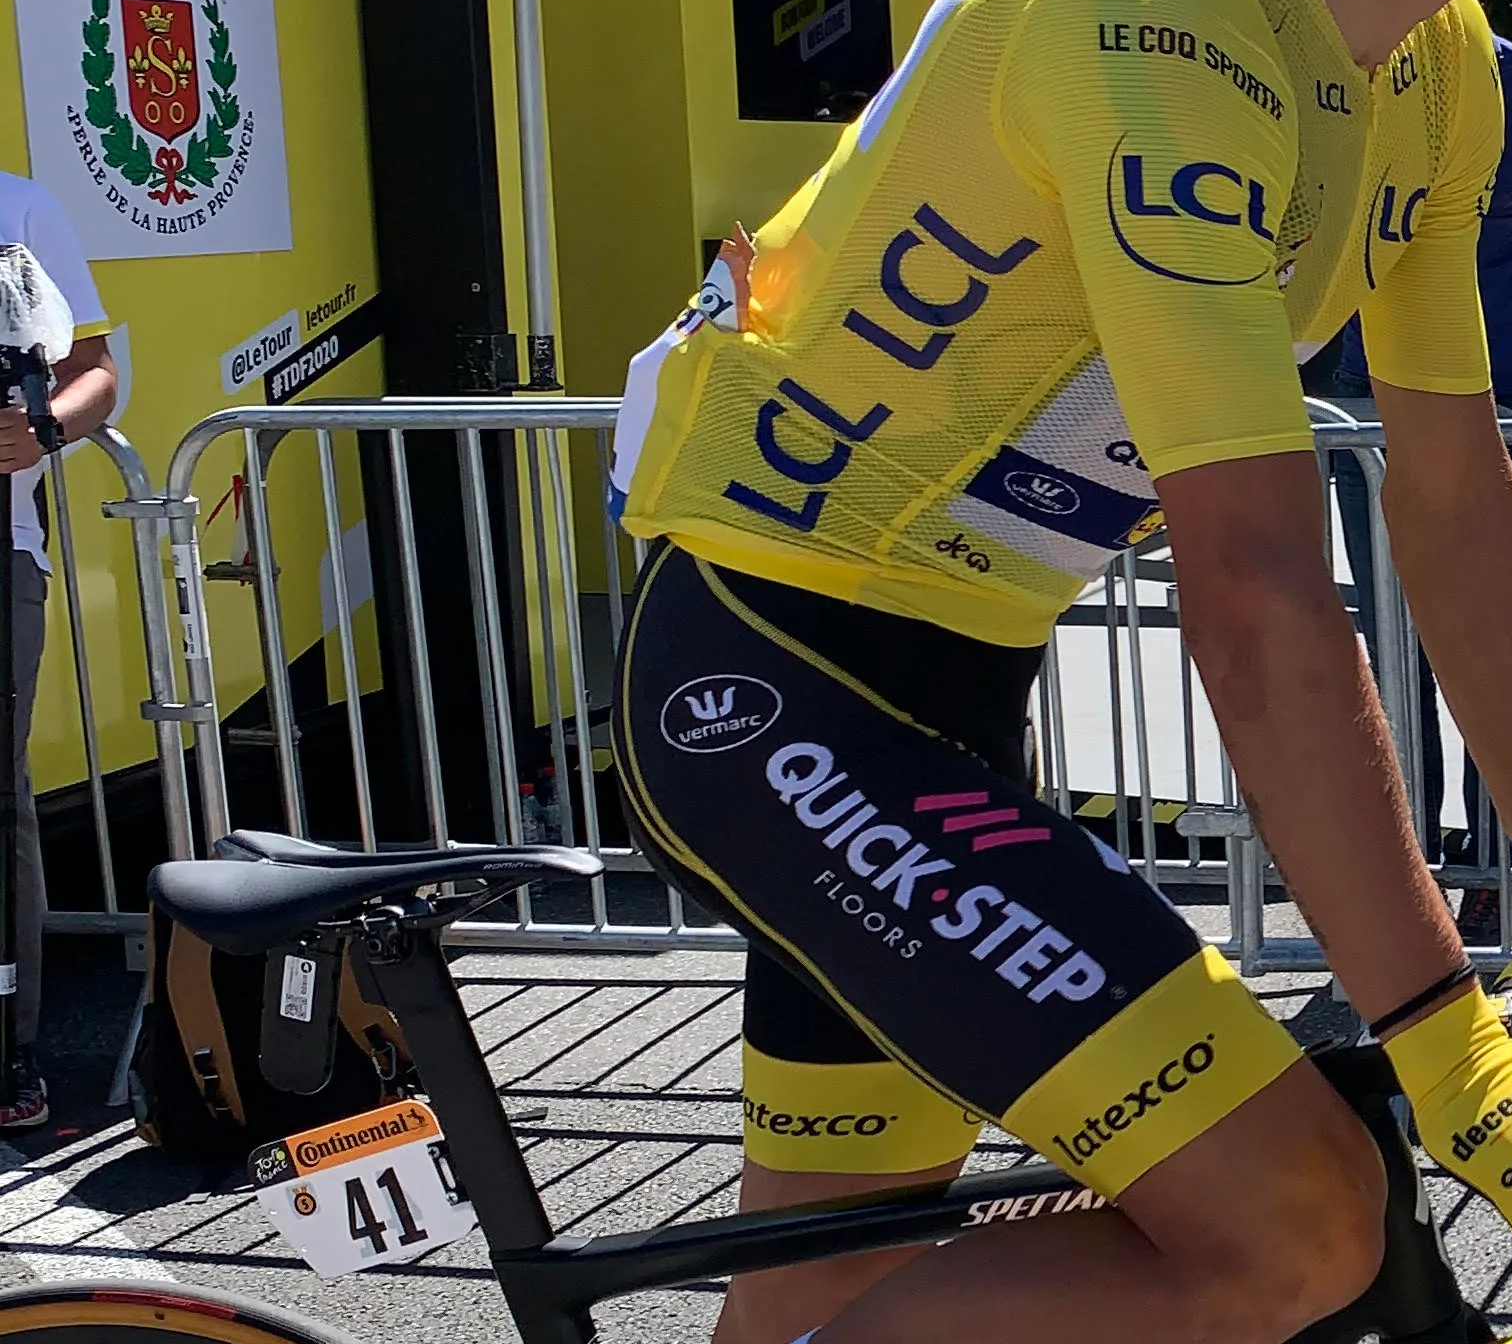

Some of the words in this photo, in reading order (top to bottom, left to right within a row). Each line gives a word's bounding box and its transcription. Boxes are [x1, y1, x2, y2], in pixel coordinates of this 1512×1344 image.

[1099, 22, 1130, 52] LE
[1138, 25, 1198, 63] COQ
[1316, 79, 1352, 115] LCL
[105, 184, 129, 214] DE
[131, 207, 152, 231] LA
[156, 208, 207, 235] HAUTE
[1122, 155, 1276, 241] LCL
[306, 284, 357, 331] letour.fr
[842, 202, 1043, 371] LCL
[231, 326, 293, 385] @LeTour
[271, 334, 340, 400] #TDF2020
[722, 376, 894, 533] LCL
[678, 714, 763, 744] vermarc
[813, 869, 923, 959] FLOORS
[743, 1096, 888, 1137] atexco
[1051, 1040, 1212, 1167] latexco
[296, 1113, 410, 1169] Continental
[344, 1167, 429, 1255] 41
